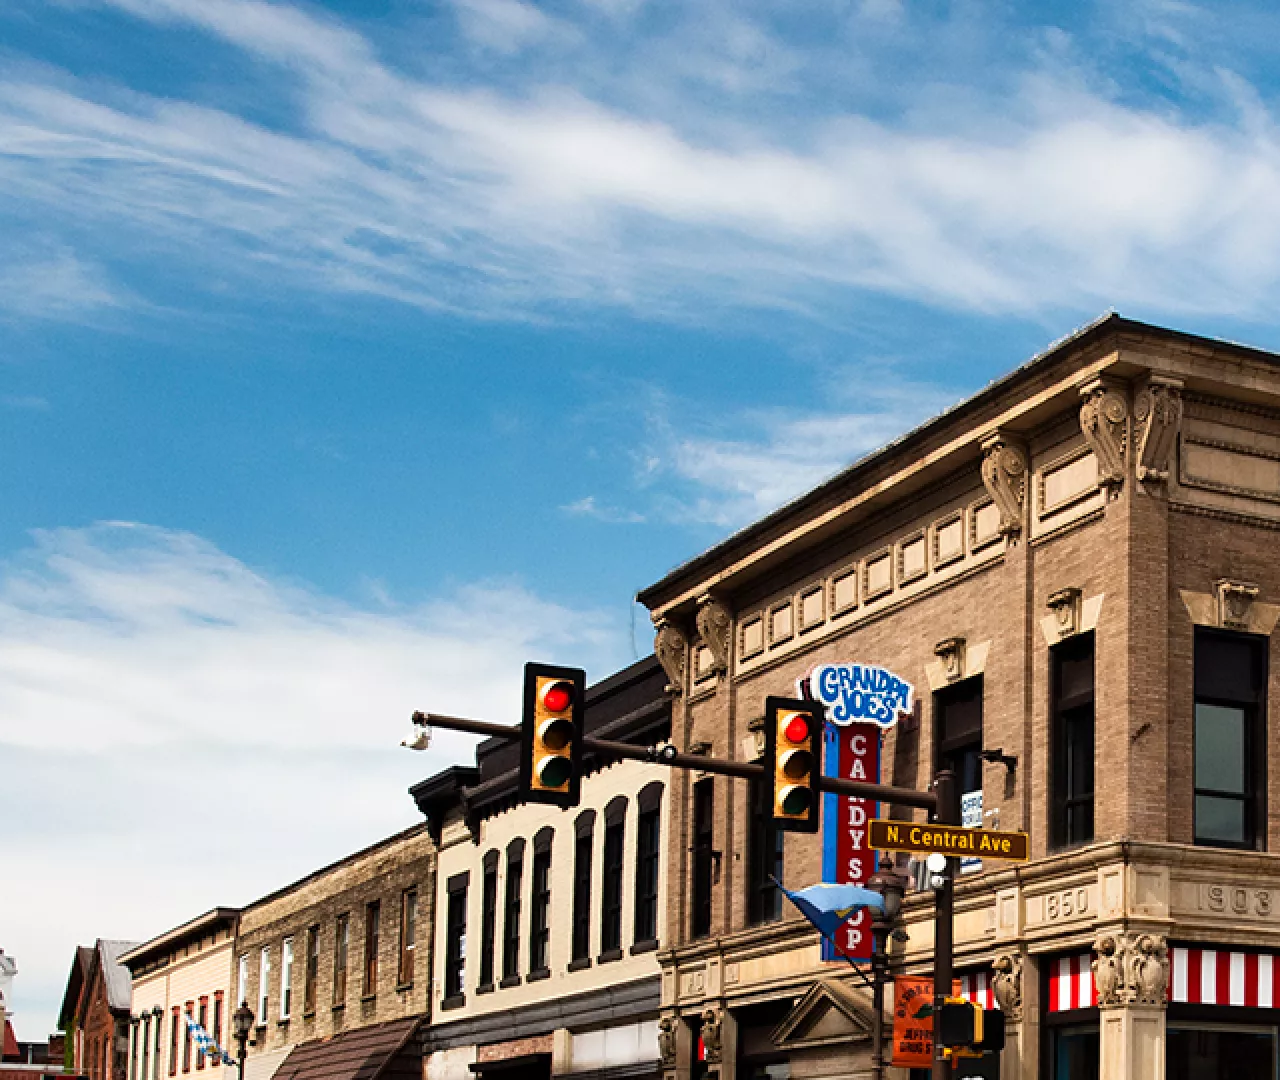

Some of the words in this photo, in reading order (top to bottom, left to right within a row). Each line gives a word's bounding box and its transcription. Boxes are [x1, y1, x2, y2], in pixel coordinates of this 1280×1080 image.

[848, 735, 867, 850] CADY
[887, 826, 905, 844] N.
[909, 827, 975, 849] Central
[980, 834, 1011, 853] Ave
